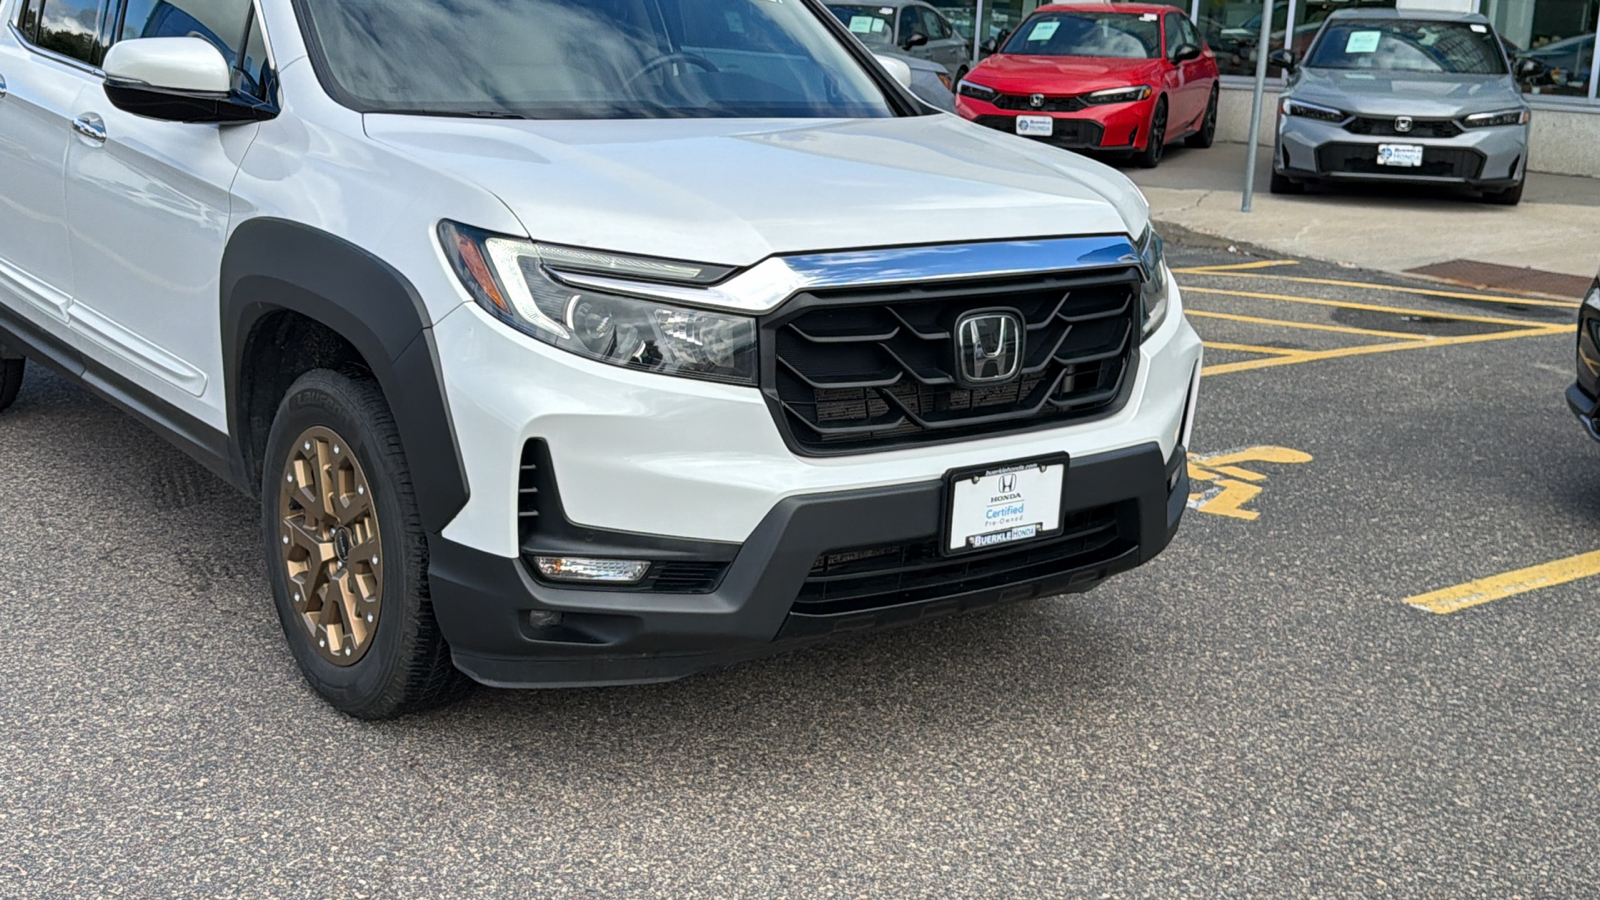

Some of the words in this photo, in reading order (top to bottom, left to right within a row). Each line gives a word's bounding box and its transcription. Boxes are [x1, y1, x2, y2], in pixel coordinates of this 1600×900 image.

[990, 492, 1021, 503] HONDA
[985, 503, 1024, 519] Certified
[985, 515, 1023, 527] Pre-Owned
[974, 531, 1012, 546] BUERKLE
